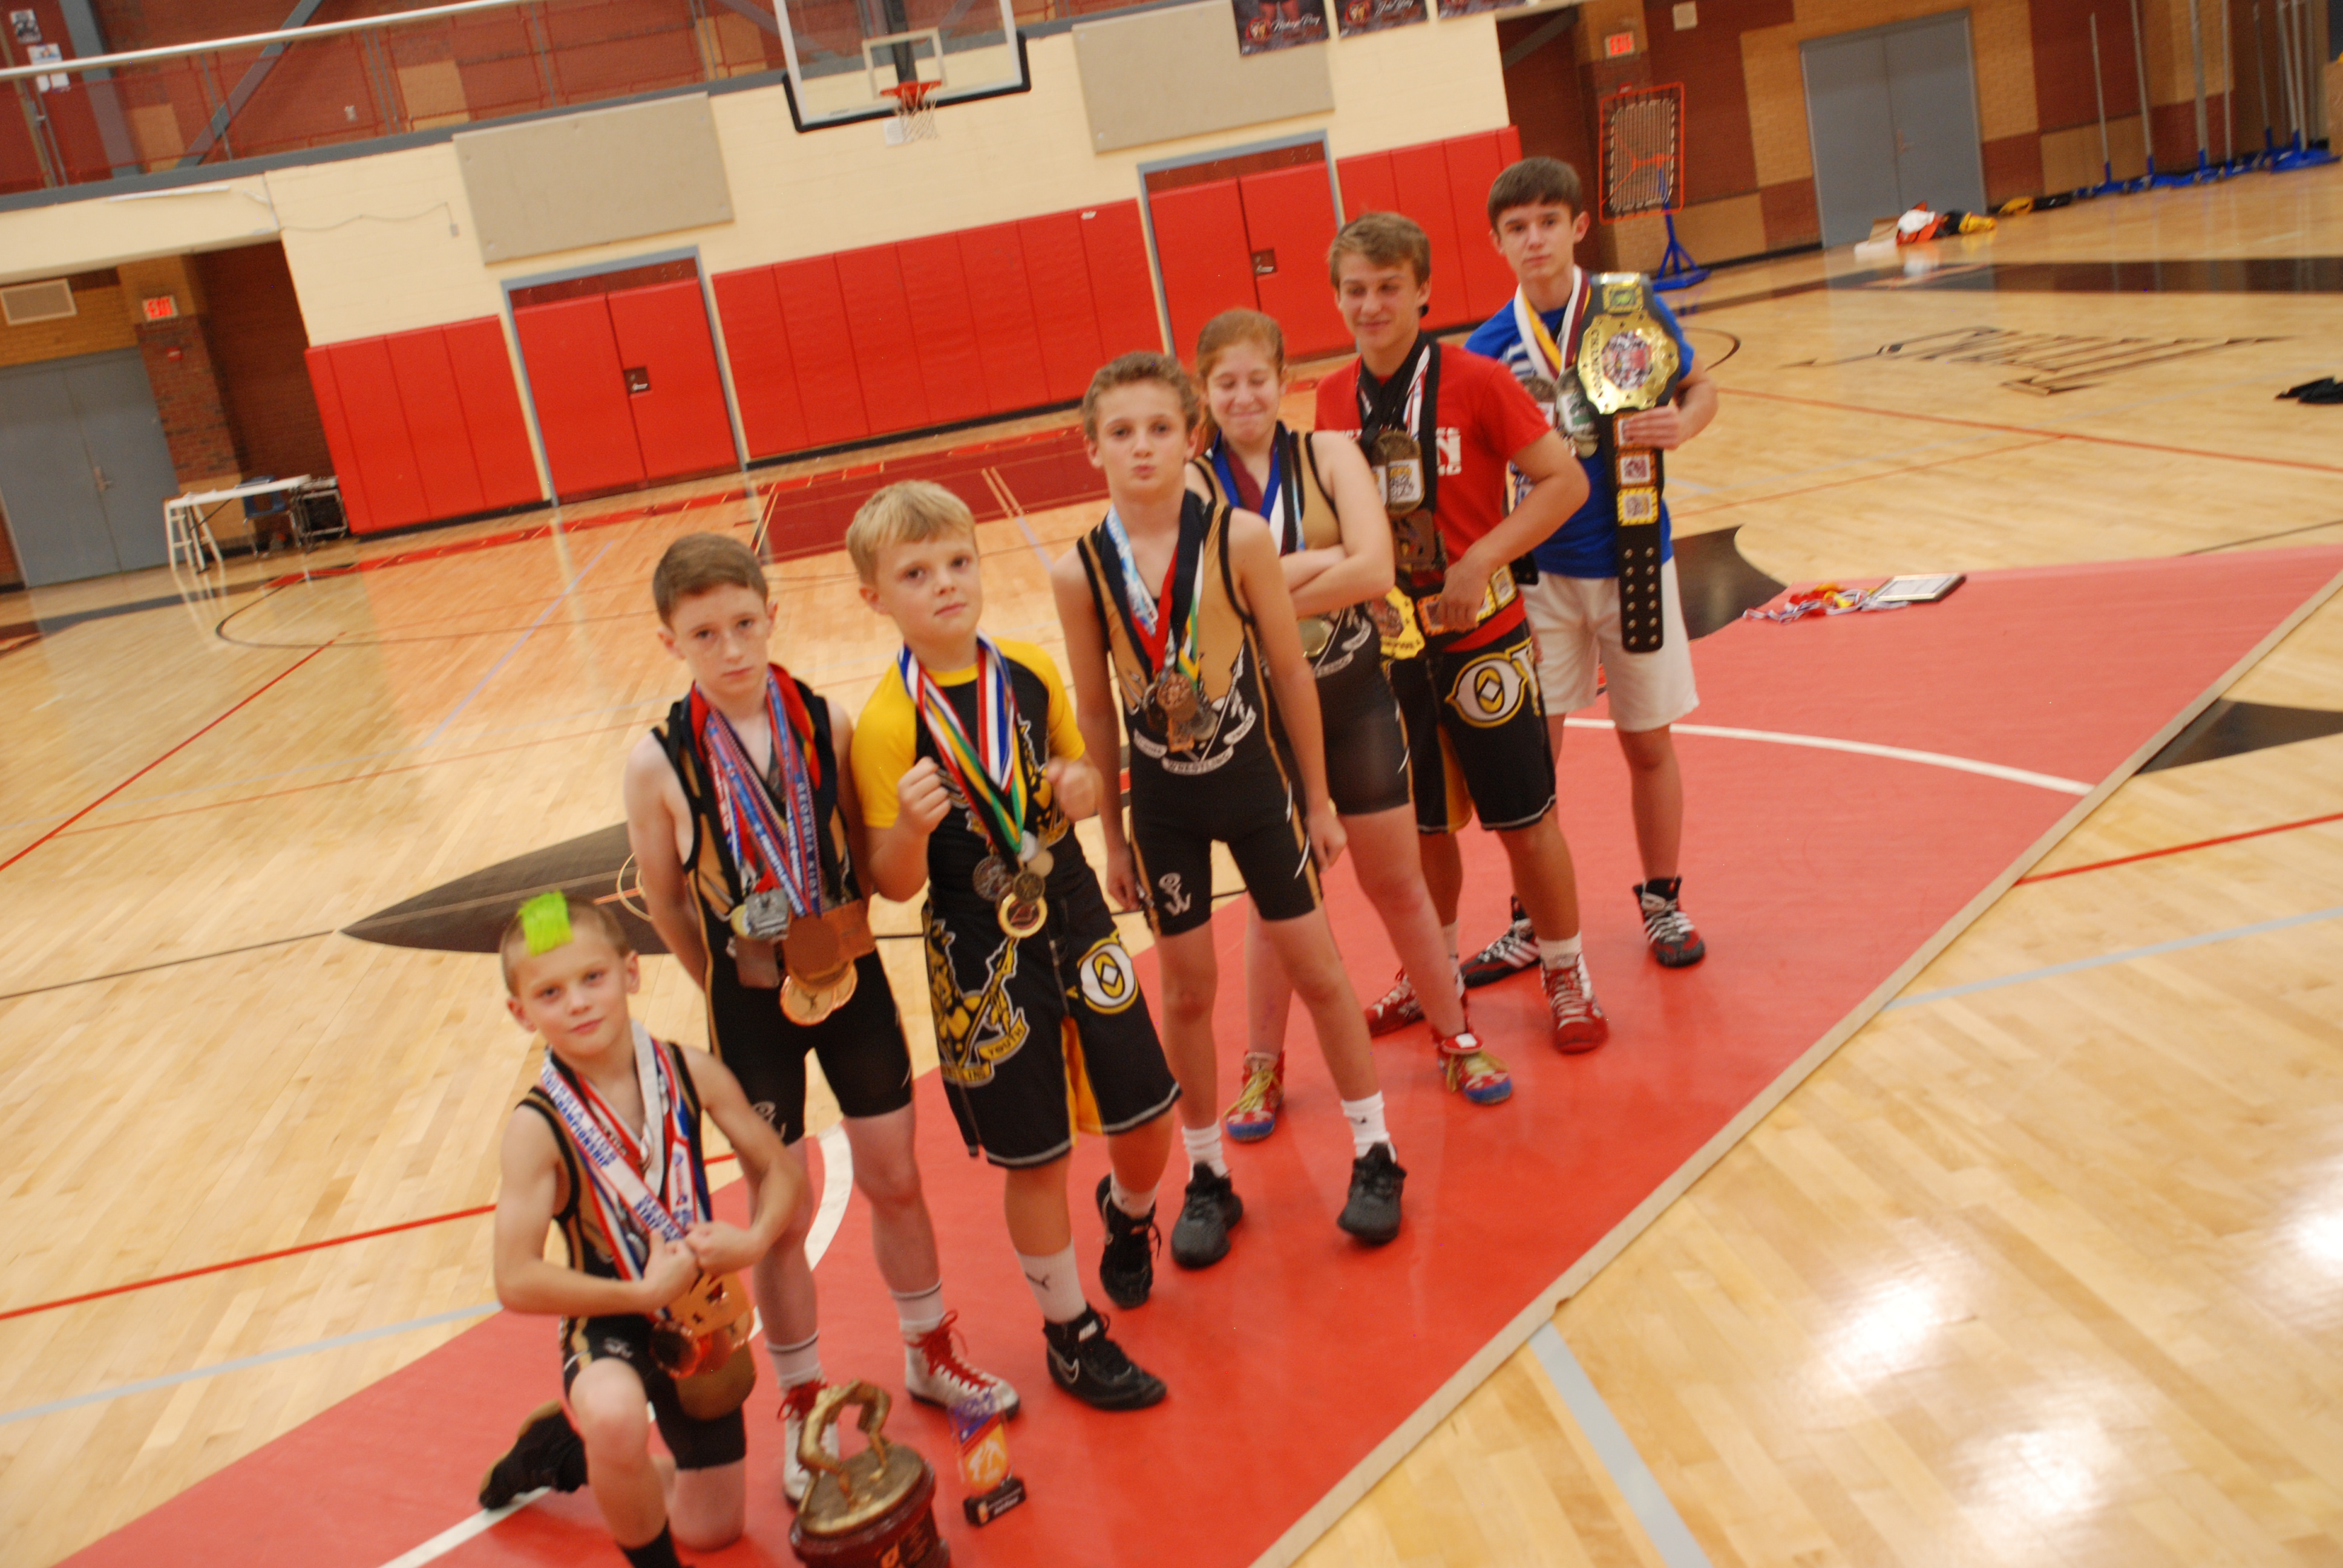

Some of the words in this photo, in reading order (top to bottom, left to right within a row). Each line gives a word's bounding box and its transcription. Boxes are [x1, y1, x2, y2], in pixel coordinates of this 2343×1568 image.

[1610, 33, 1631, 56] EXIT
[146, 296, 172, 319] EXIT
[796, 781, 814, 852] GEORGIA
[807, 860, 819, 900] KIDS
[988, 1026, 1024, 1057] YOUTH
